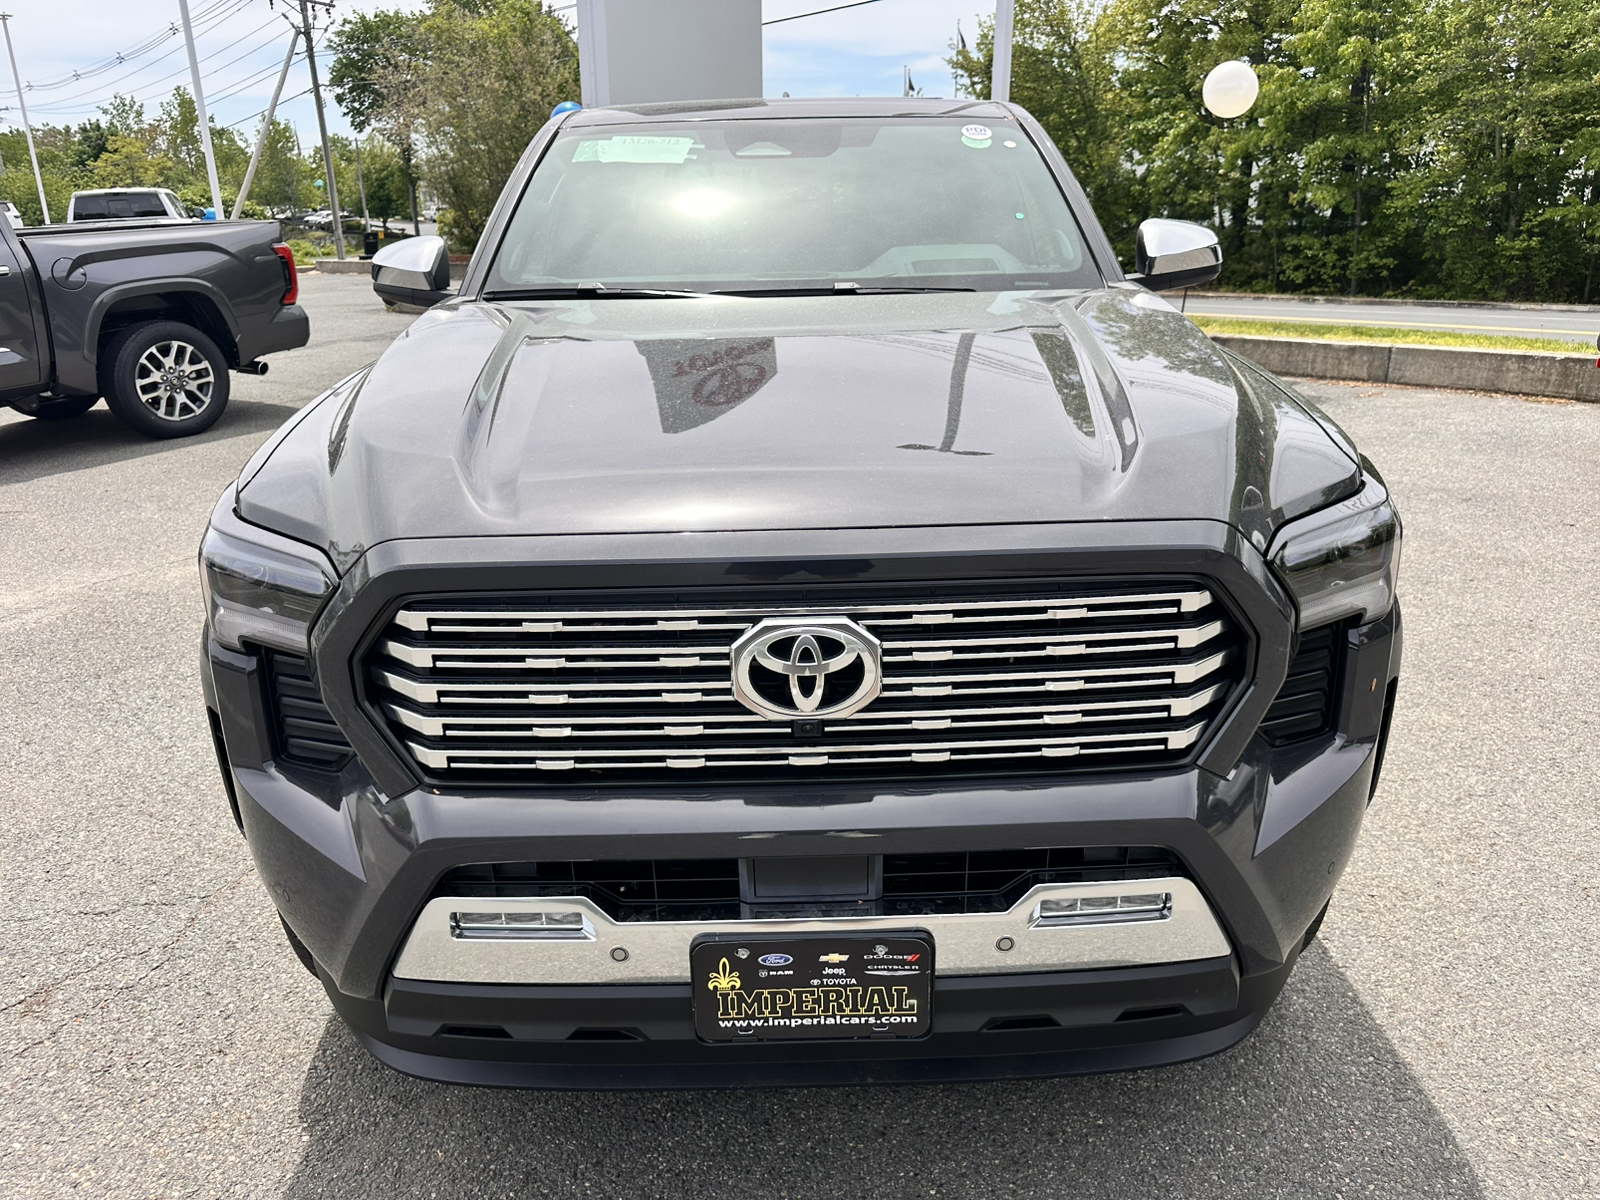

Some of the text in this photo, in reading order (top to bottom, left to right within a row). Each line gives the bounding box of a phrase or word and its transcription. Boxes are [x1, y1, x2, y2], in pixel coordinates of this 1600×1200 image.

[765, 956, 786, 964] Ford
[822, 966, 846, 976] Jeep
[822, 977, 858, 985] TOYOTA
[717, 986, 918, 1018] IMPERIAL
[718, 1014, 918, 1027] www.imperialcars.com
